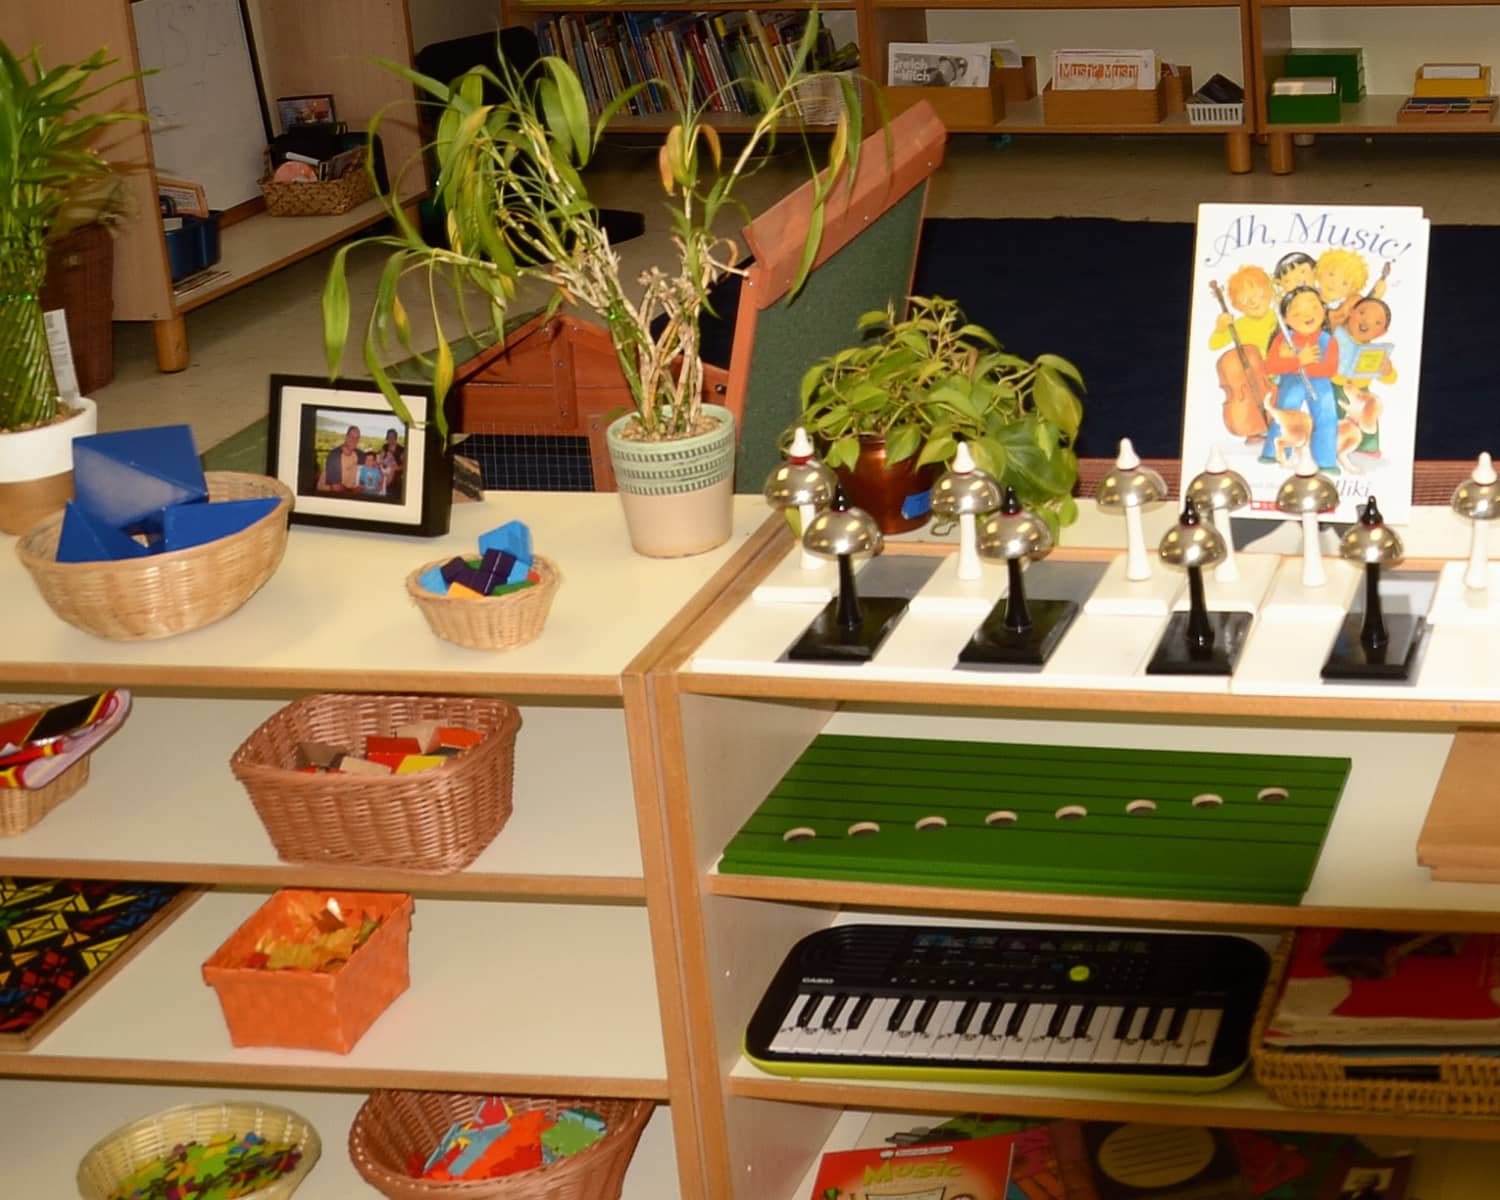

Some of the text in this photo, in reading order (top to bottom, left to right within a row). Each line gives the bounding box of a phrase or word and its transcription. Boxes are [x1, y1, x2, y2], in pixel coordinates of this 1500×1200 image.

[1204, 211, 1412, 268] Ah, Music!
[1335, 479, 1370, 498] liki
[801, 976, 835, 985] CASIO
[862, 1156, 966, 1187] Music
